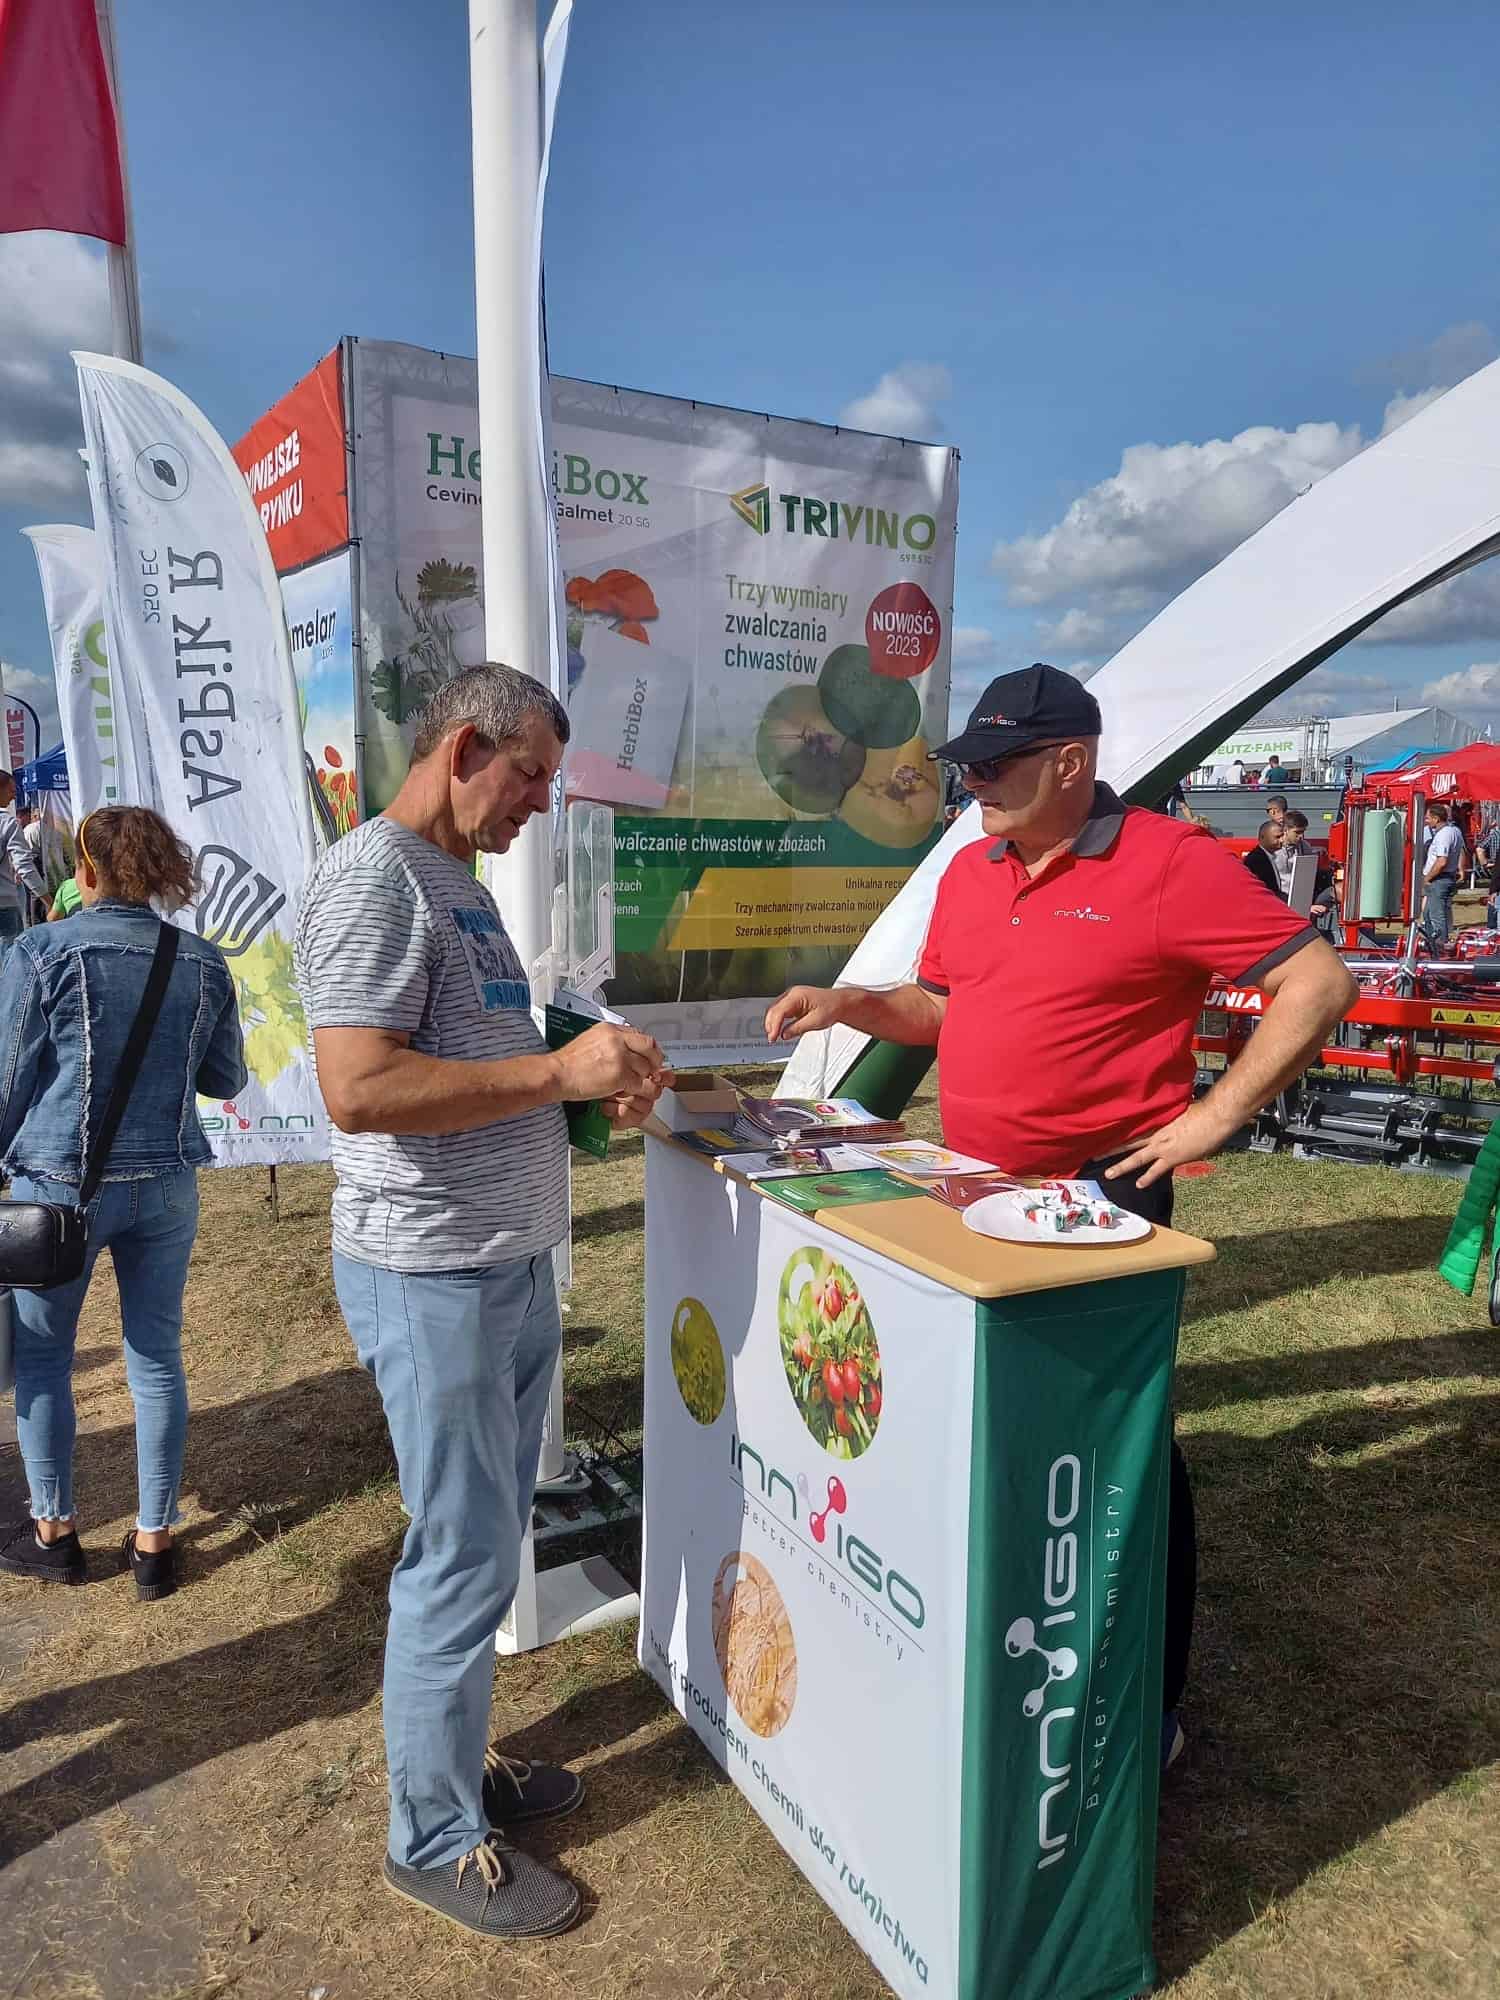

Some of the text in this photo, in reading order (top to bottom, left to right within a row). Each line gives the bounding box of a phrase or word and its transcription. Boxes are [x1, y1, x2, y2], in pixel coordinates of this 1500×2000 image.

[427, 433, 649, 504] HeiBox
[260, 480, 303, 534] RYNKU
[426, 484, 482, 505] Cevin
[779, 494, 936, 550] TRIVINO
[725, 574, 848, 618] Trzy wymiary
[725, 612, 827, 643] zwalczania
[872, 610, 935, 636] NOWOŚĆ
[724, 645, 817, 675] chwastów
[885, 634, 921, 657] 2023
[616, 677, 648, 773] HerbiBox
[691, 834, 762, 852] chwastów
[766, 838, 776, 852] w
[778, 835, 826, 852] zbożach
[845, 878, 882, 890] Unikalna
[734, 902, 753, 916] Trzy
[756, 901, 803, 915] mechanizmy
[806, 899, 855, 912] zwalczania
[735, 926, 772, 937] Szerokie
[774, 925, 811, 938] spektrum
[813, 923, 856, 934] chwastów
[1203, 989, 1263, 1010] UNIA
[743, 1500, 905, 1661] Better chemistry
[1086, 1482, 1125, 1810] Better chemistry
[680, 1673, 929, 1985] producent chemii dla rolnictwa
